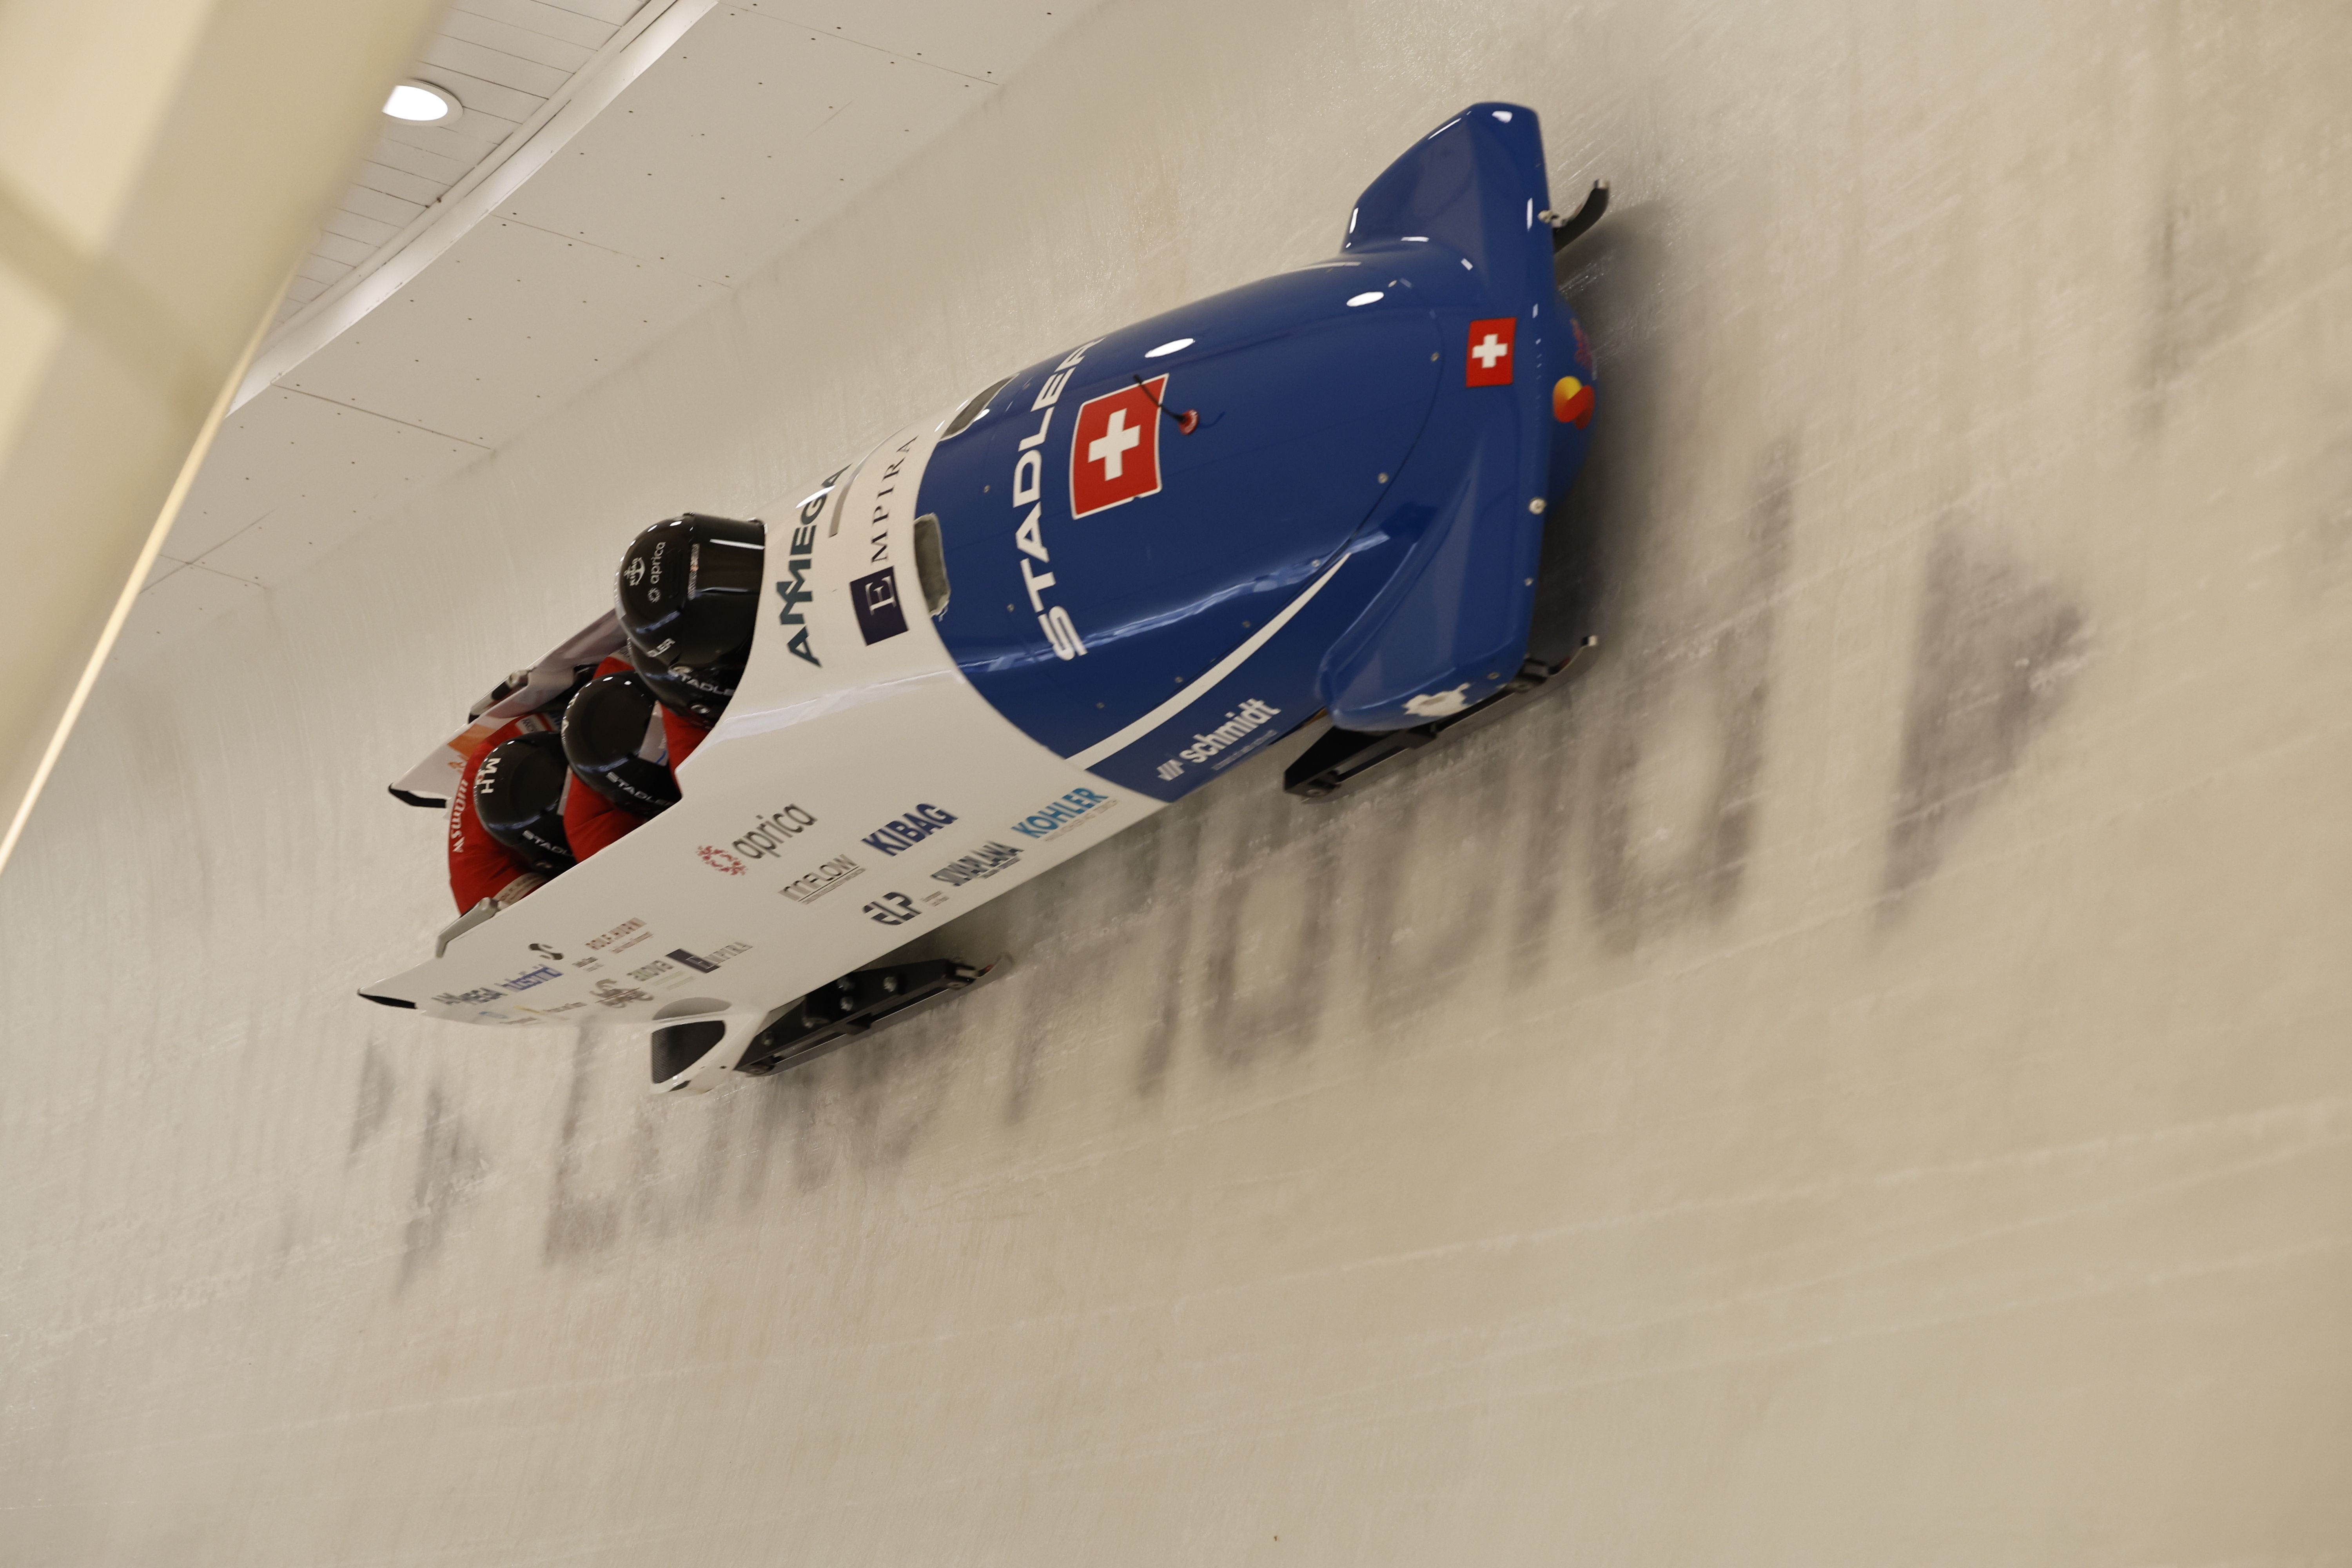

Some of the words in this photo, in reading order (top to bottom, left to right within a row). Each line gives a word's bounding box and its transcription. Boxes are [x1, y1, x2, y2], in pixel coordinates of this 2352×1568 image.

[866, 435, 918, 615] EMPIRA
[1013, 337, 1105, 660] STADLER
[650, 542, 666, 584] aprica
[1180, 698, 1281, 763] schmidt
[732, 804, 818, 858] aprica
[862, 803, 958, 857] KIBAG
[1011, 787, 1109, 838] KOHLER
